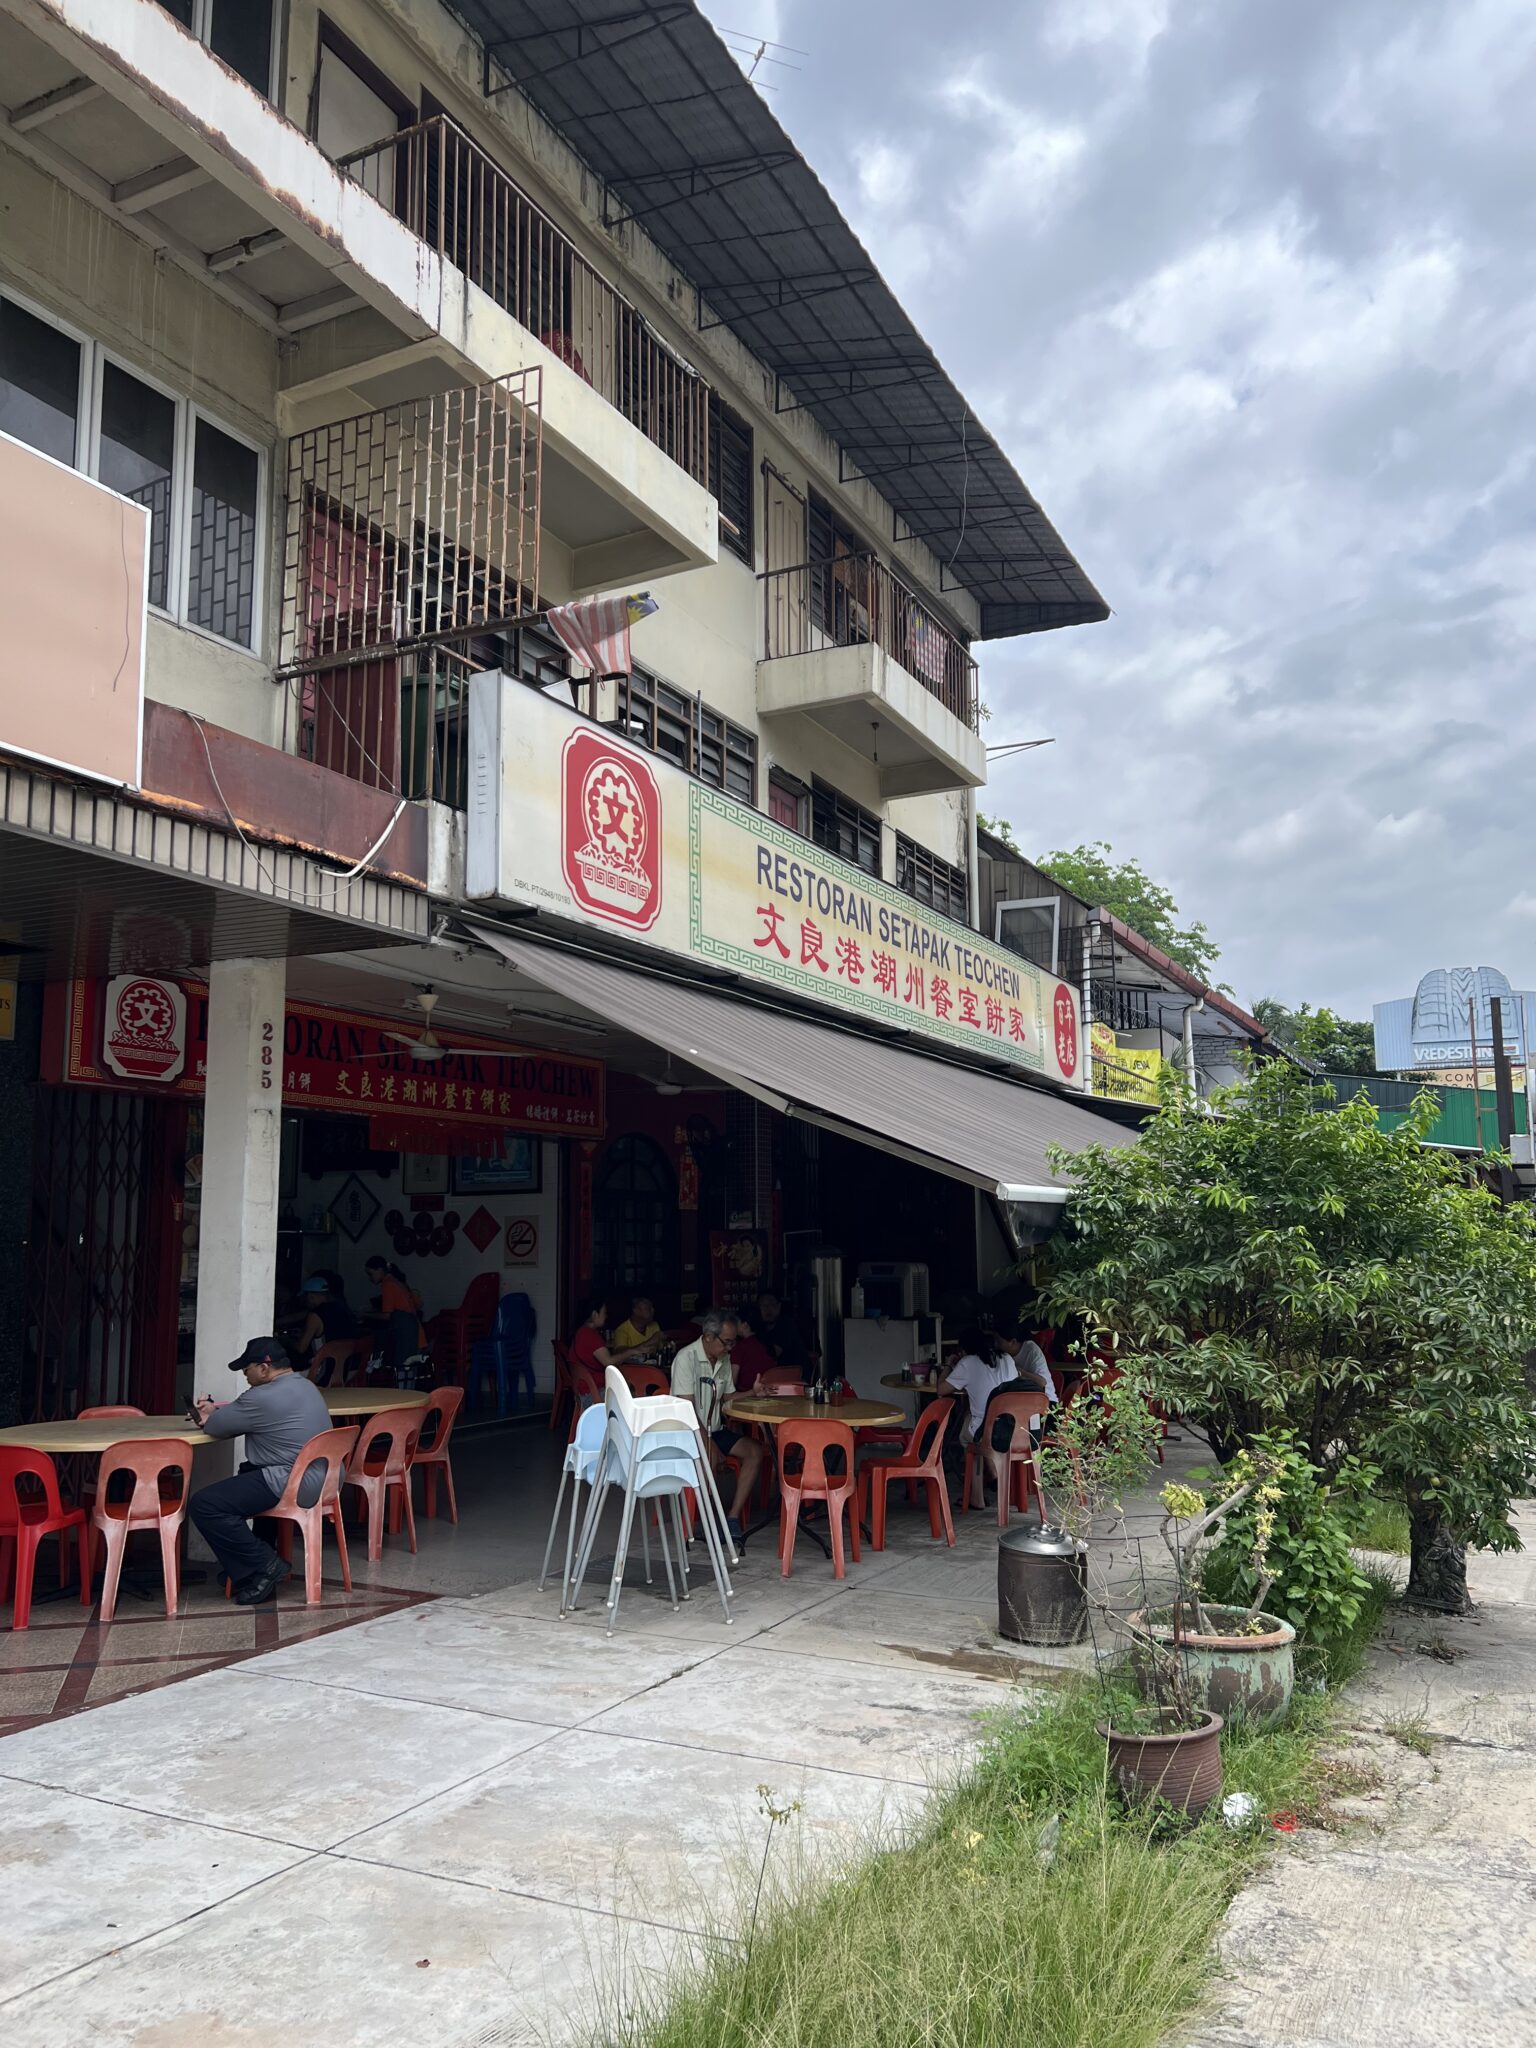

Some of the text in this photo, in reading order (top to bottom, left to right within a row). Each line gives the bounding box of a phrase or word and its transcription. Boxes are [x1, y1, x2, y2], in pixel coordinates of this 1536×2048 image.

[602, 791, 629, 843] 文
[514, 878, 530, 891] DBKL
[756, 844, 1021, 1001] RESTORAN SETAPAK TEOCHEW
[753, 902, 1027, 1043] 文良港潮州餐室餅家
[134, 999, 160, 1028] 文
[261, 1022, 273, 1089] 285
